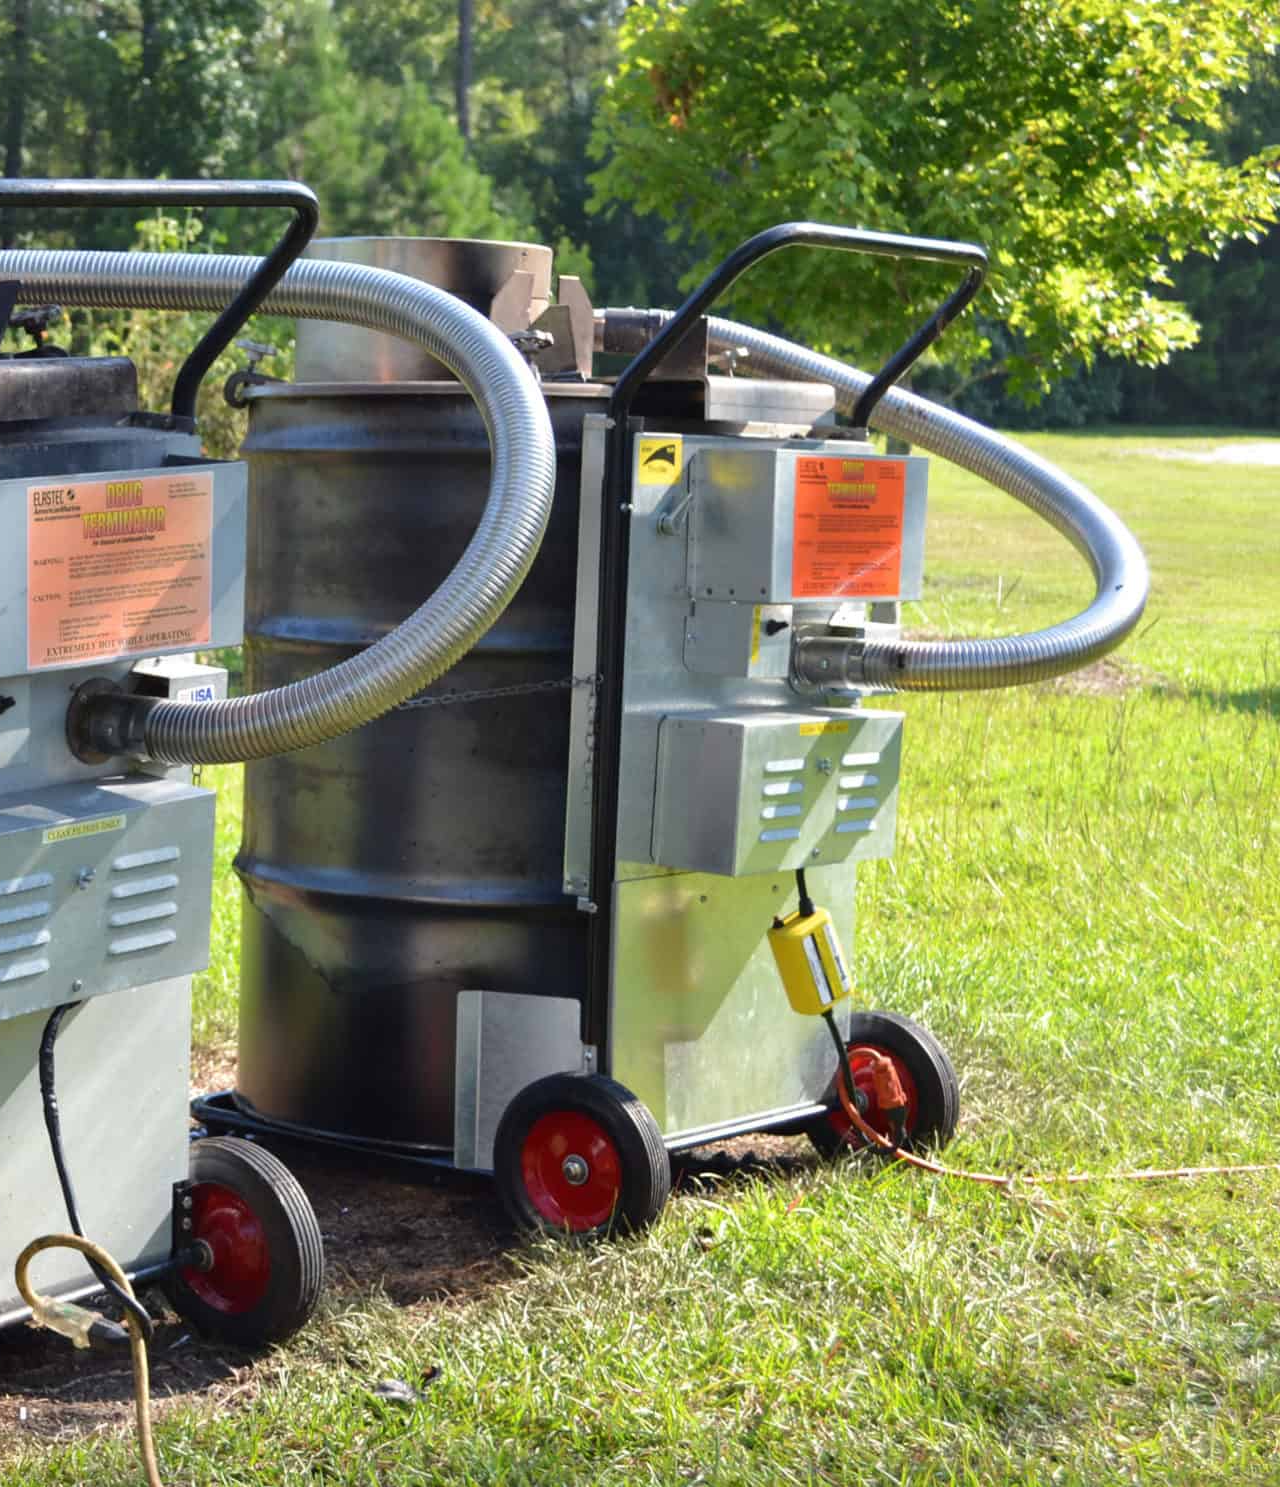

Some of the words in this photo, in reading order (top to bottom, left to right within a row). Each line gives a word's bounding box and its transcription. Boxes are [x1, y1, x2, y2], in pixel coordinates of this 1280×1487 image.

[33, 489, 65, 507] ELASTEC
[106, 480, 143, 509] DRUG
[81, 505, 167, 539] TERMINATOR
[47, 640, 97, 657] EXTREMELY
[98, 638, 115, 649] HOT
[145, 629, 193, 643] OPERATING
[191, 687, 213, 703] USA
